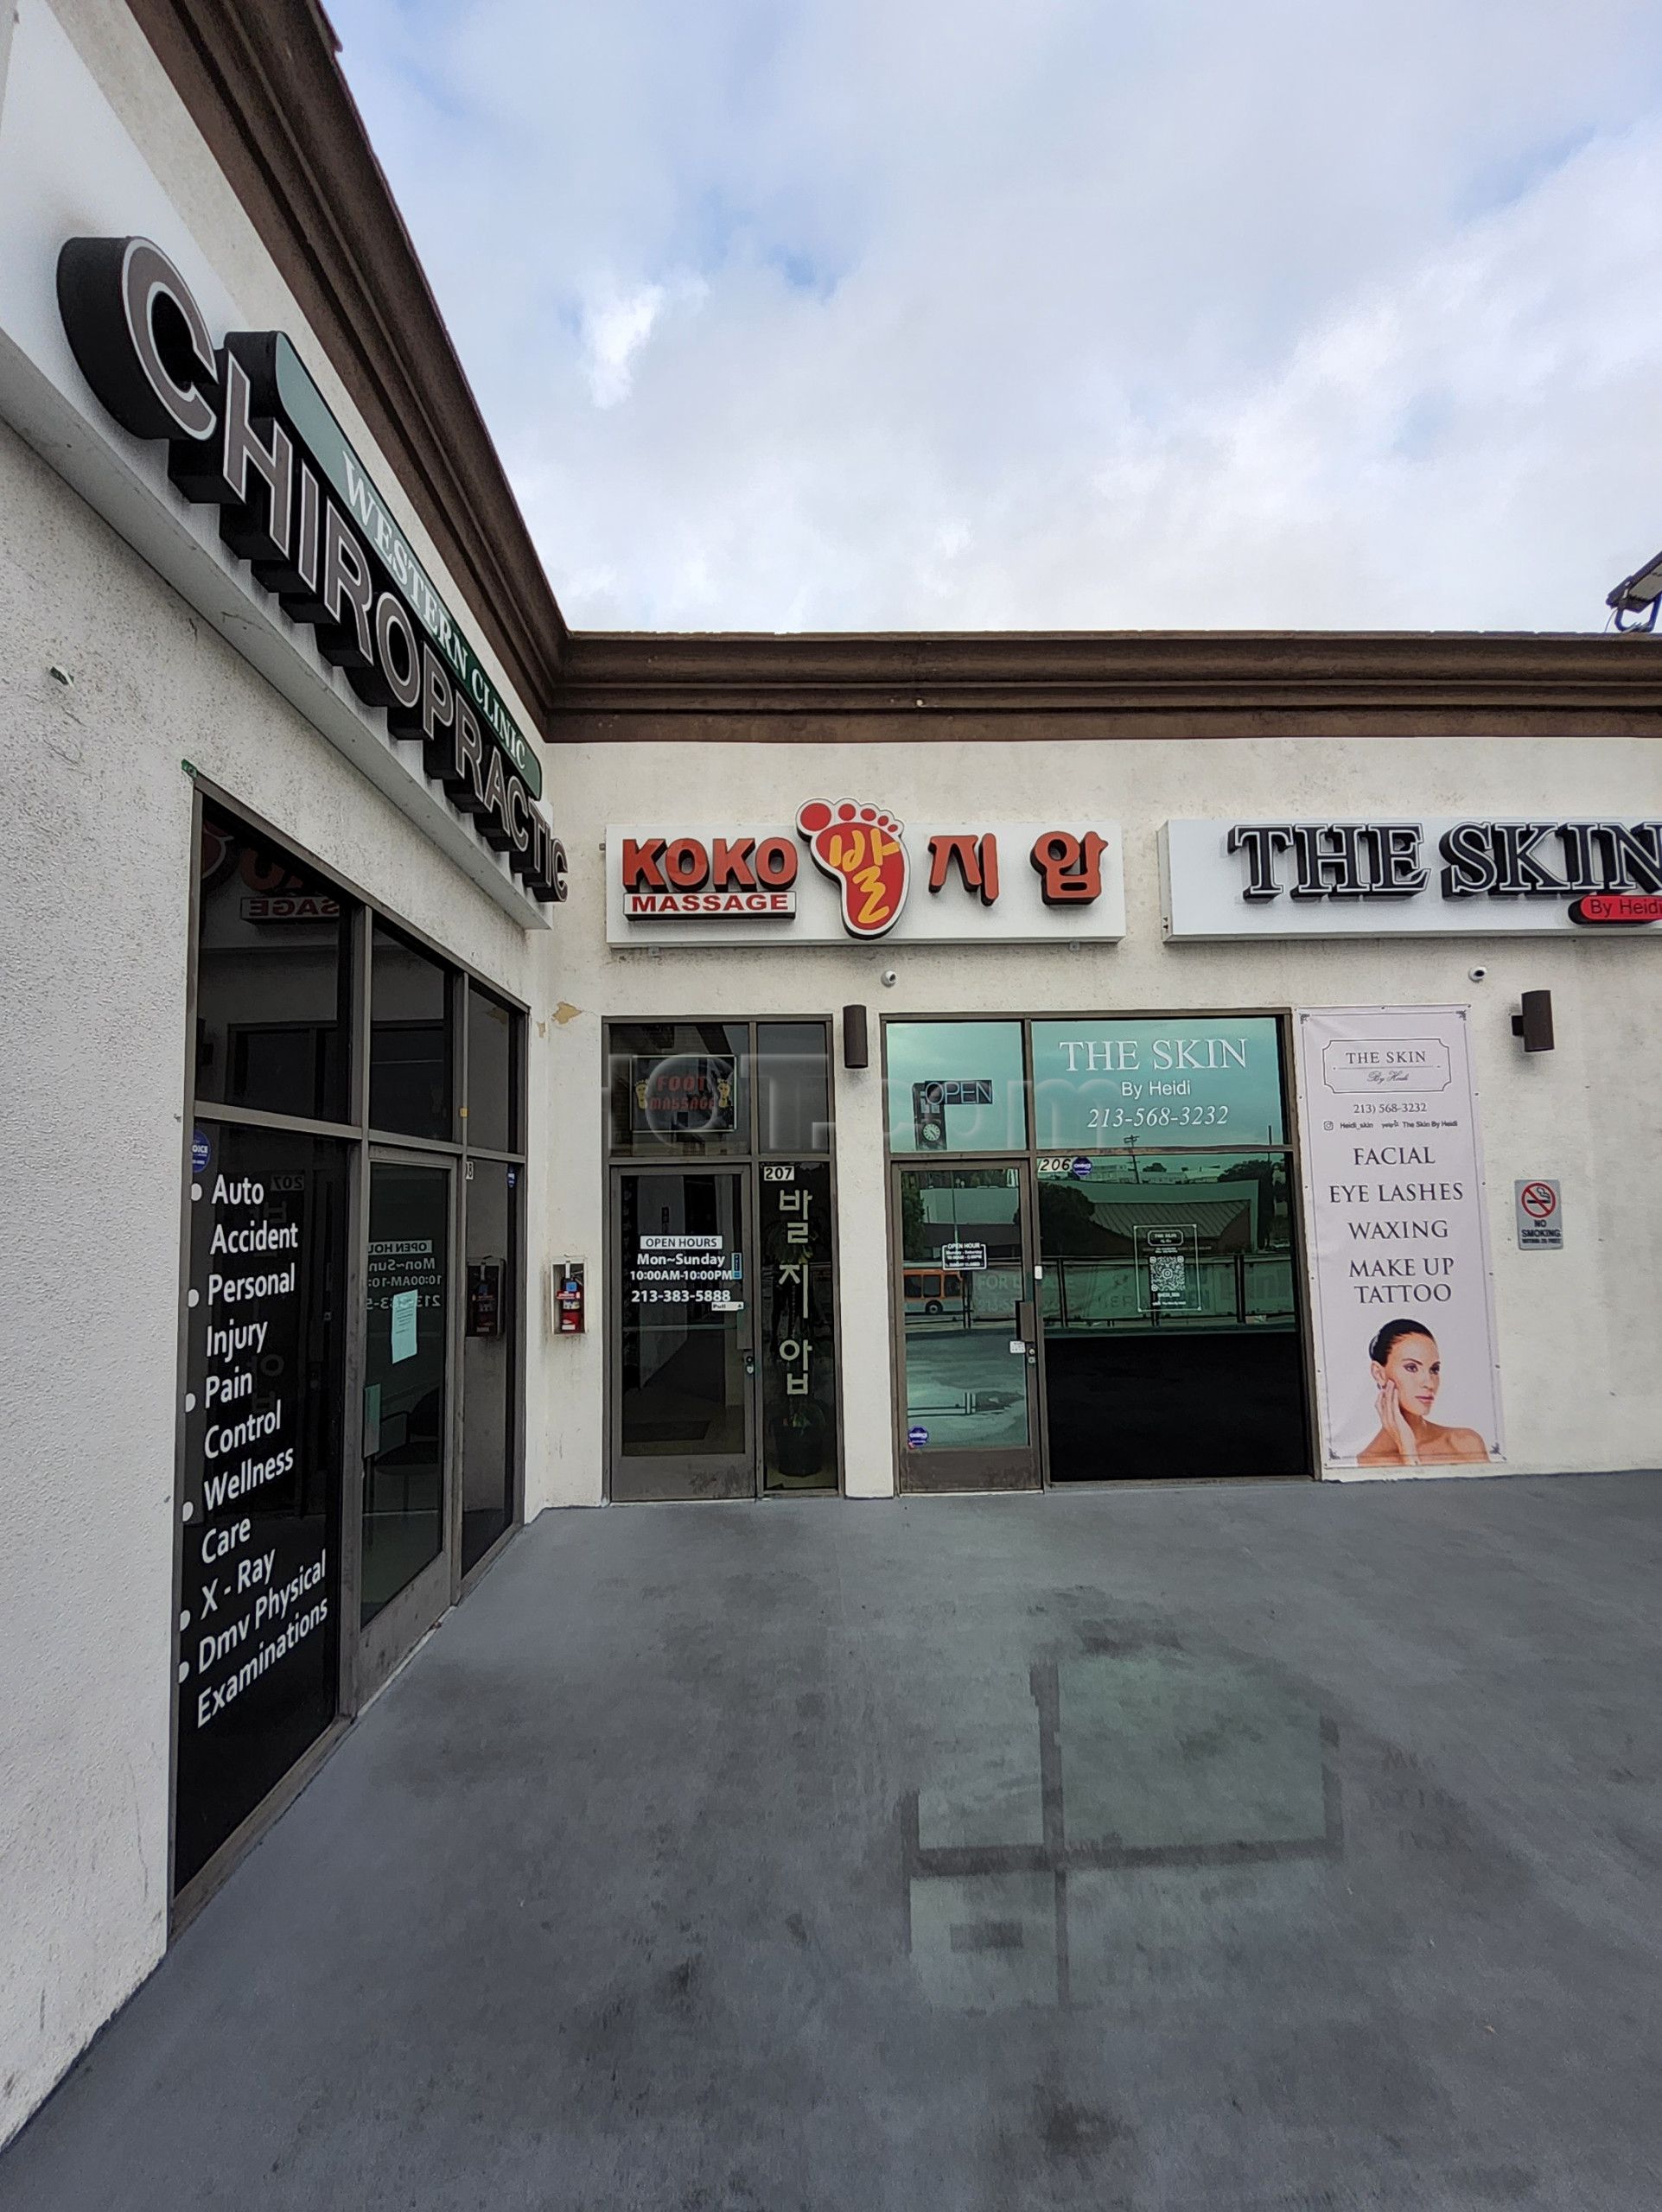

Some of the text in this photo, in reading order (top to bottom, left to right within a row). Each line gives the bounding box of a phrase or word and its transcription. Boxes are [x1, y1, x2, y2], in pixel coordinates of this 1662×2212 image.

[57, 235, 568, 904] CHIROPRACTIC
[342, 448, 526, 771] WESTERN CLINIC
[622, 836, 799, 892] KOKO
[1227, 822, 1662, 903] THE SKIN
[631, 893, 789, 912] MASSAGE
[1590, 899, 1612, 918] By
[1060, 1037, 1248, 1071] THE SKIN
[1346, 1051, 1426, 1064] THE SKIN
[656, 1074, 707, 1092] FOOT
[925, 1081, 991, 1105] OPEN
[1122, 1081, 1191, 1100] By Heidi
[649, 1096, 716, 1111] MASSAGE
[1353, 1103, 1427, 1115] 213) 568-3232
[1087, 1105, 1229, 1128] 213-568-3232
[1041, 1159, 1071, 1172] 206
[1353, 1147, 1436, 1166] FACIAL
[766, 1166, 793, 1180] 207
[211, 1173, 264, 1205] Auto
[1329, 1183, 1463, 1204] EYE LASHES
[1348, 1220, 1449, 1240] WAXING
[1522, 1229, 1561, 1237] SMOKING
[1534, 1219, 1547, 1228] NO
[210, 1219, 298, 1255] Accident
[646, 1237, 717, 1248] OPEN HOURS
[637, 1253, 726, 1268] Mon~Sunday
[1349, 1257, 1455, 1278] MAKE UP
[207, 1262, 296, 1306] Personal
[630, 1270, 733, 1281] 10:00AM-10:00PM
[631, 1290, 731, 1302] 213-383-5888
[1354, 1283, 1452, 1304] TATTOO
[206, 1318, 268, 1363] Injury
[205, 1365, 252, 1409] Pain
[204, 1402, 282, 1460] Control
[204, 1448, 294, 1512] Wellness
[201, 1516, 251, 1564] Care
[201, 1584, 218, 1621] X
[237, 1548, 276, 1597] Ray
[198, 1548, 326, 1675] Dmv Physical
[197, 1598, 328, 1728] Examinations
